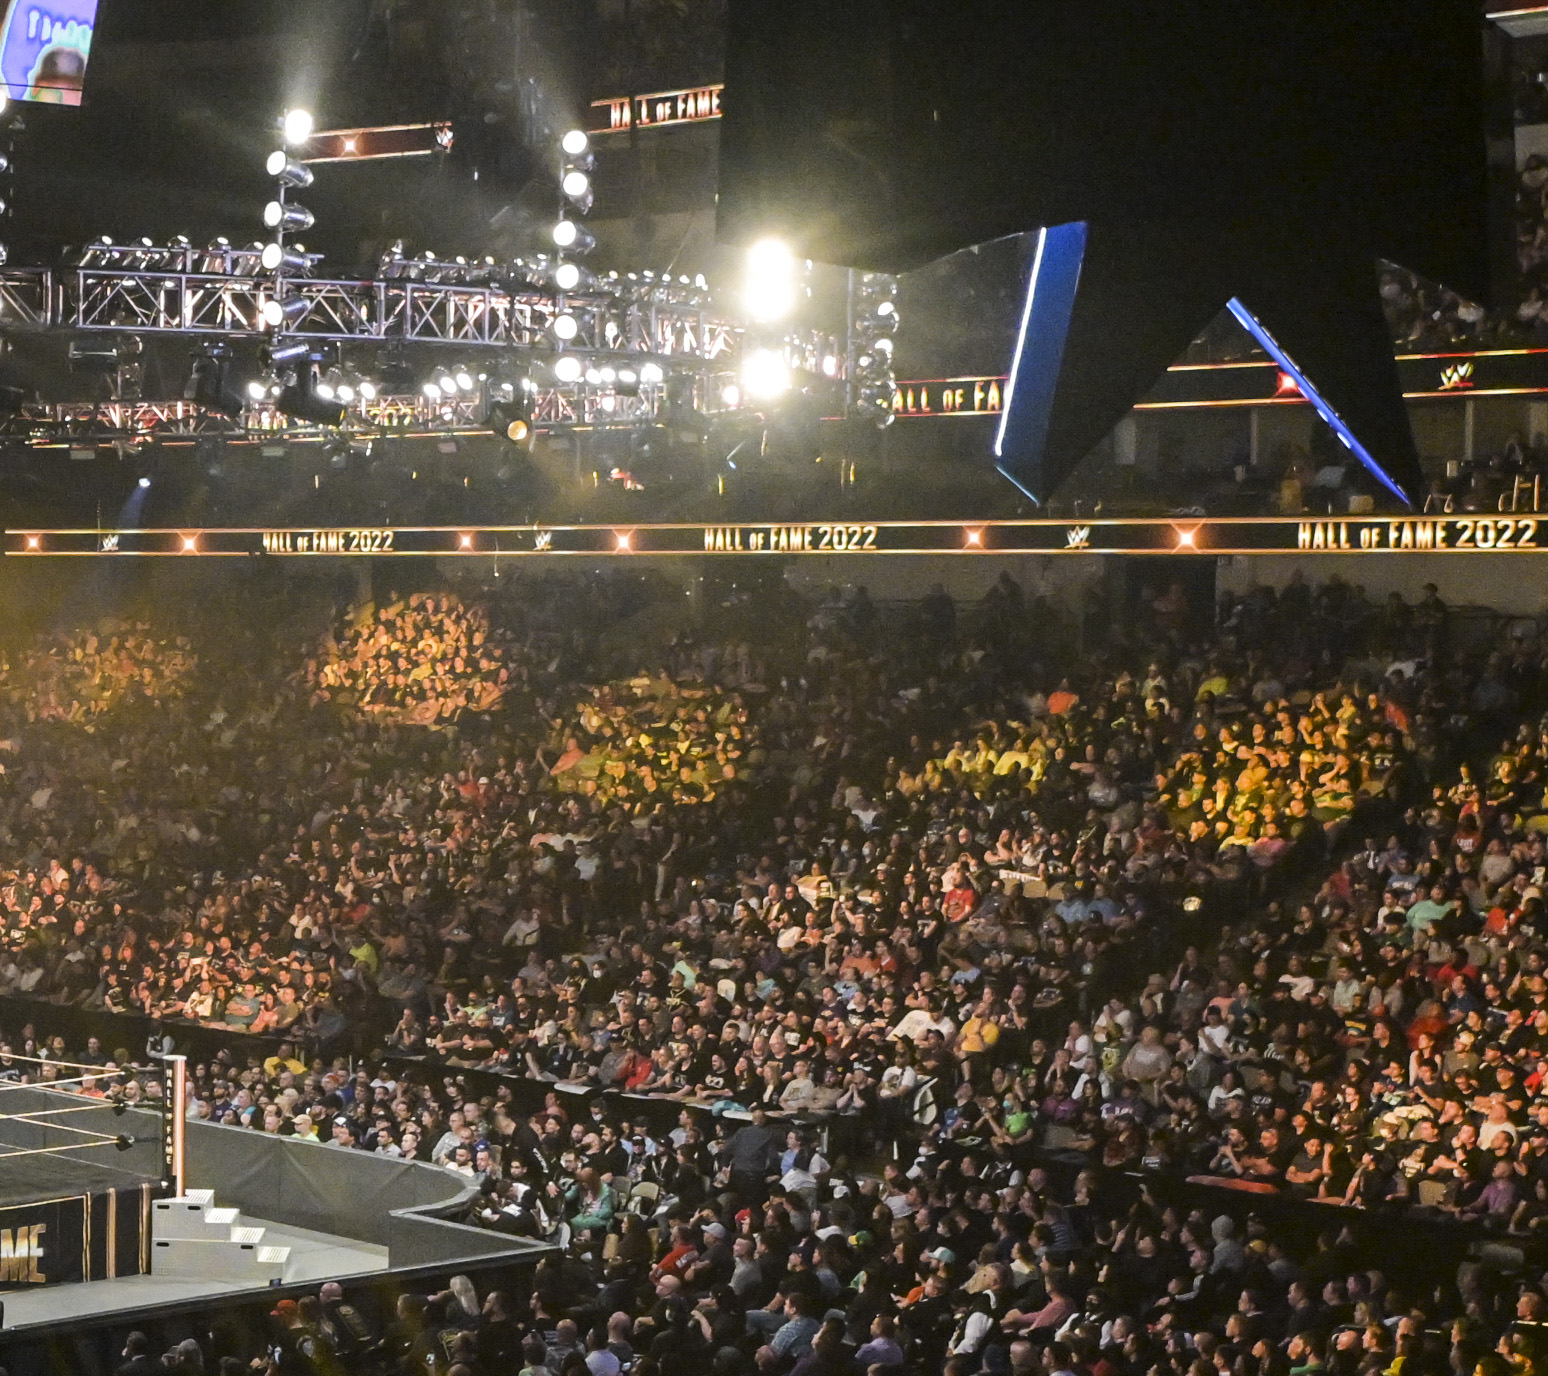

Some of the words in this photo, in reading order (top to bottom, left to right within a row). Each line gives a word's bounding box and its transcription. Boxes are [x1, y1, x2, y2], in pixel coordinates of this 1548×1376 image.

[611, 99, 651, 128] HAL
[677, 90, 721, 119] FAME
[312, 532, 345, 552] FAME
[349, 531, 394, 552] 2022
[704, 528, 742, 551] HALL
[749, 532, 764, 551] OF
[769, 527, 813, 551] FAME
[818, 526, 878, 550] 2022
[1298, 522, 1350, 549] HALL
[1359, 527, 1380, 549] OF
[1388, 520, 1447, 549] FAME
[1455, 519, 1538, 549] 2022
